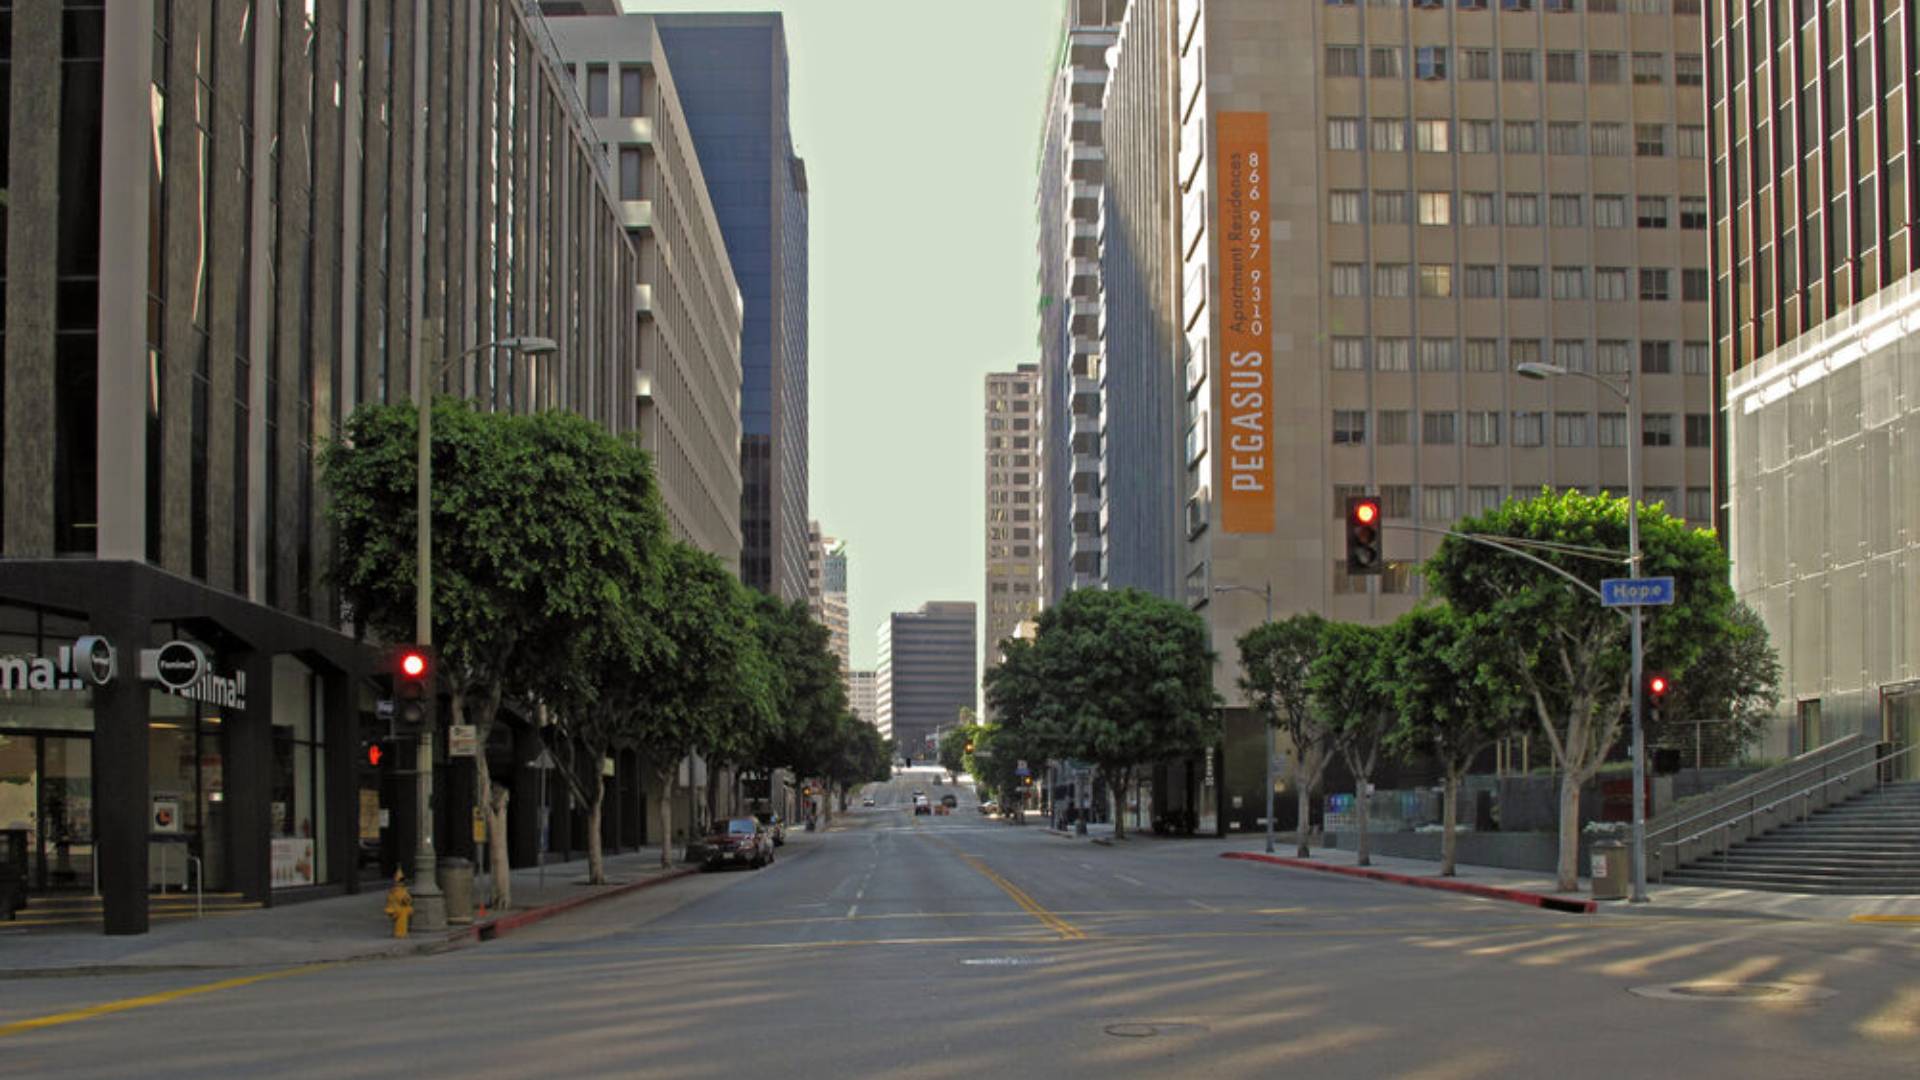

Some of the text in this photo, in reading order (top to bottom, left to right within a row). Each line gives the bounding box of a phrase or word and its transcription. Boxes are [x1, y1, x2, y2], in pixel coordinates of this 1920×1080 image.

[1228, 152, 1247, 334] Apartment Residences
[1248, 152, 1263, 337] 866 997 9310
[1230, 351, 1265, 491] PEGASUS
[1613, 584, 1662, 600] Hope
